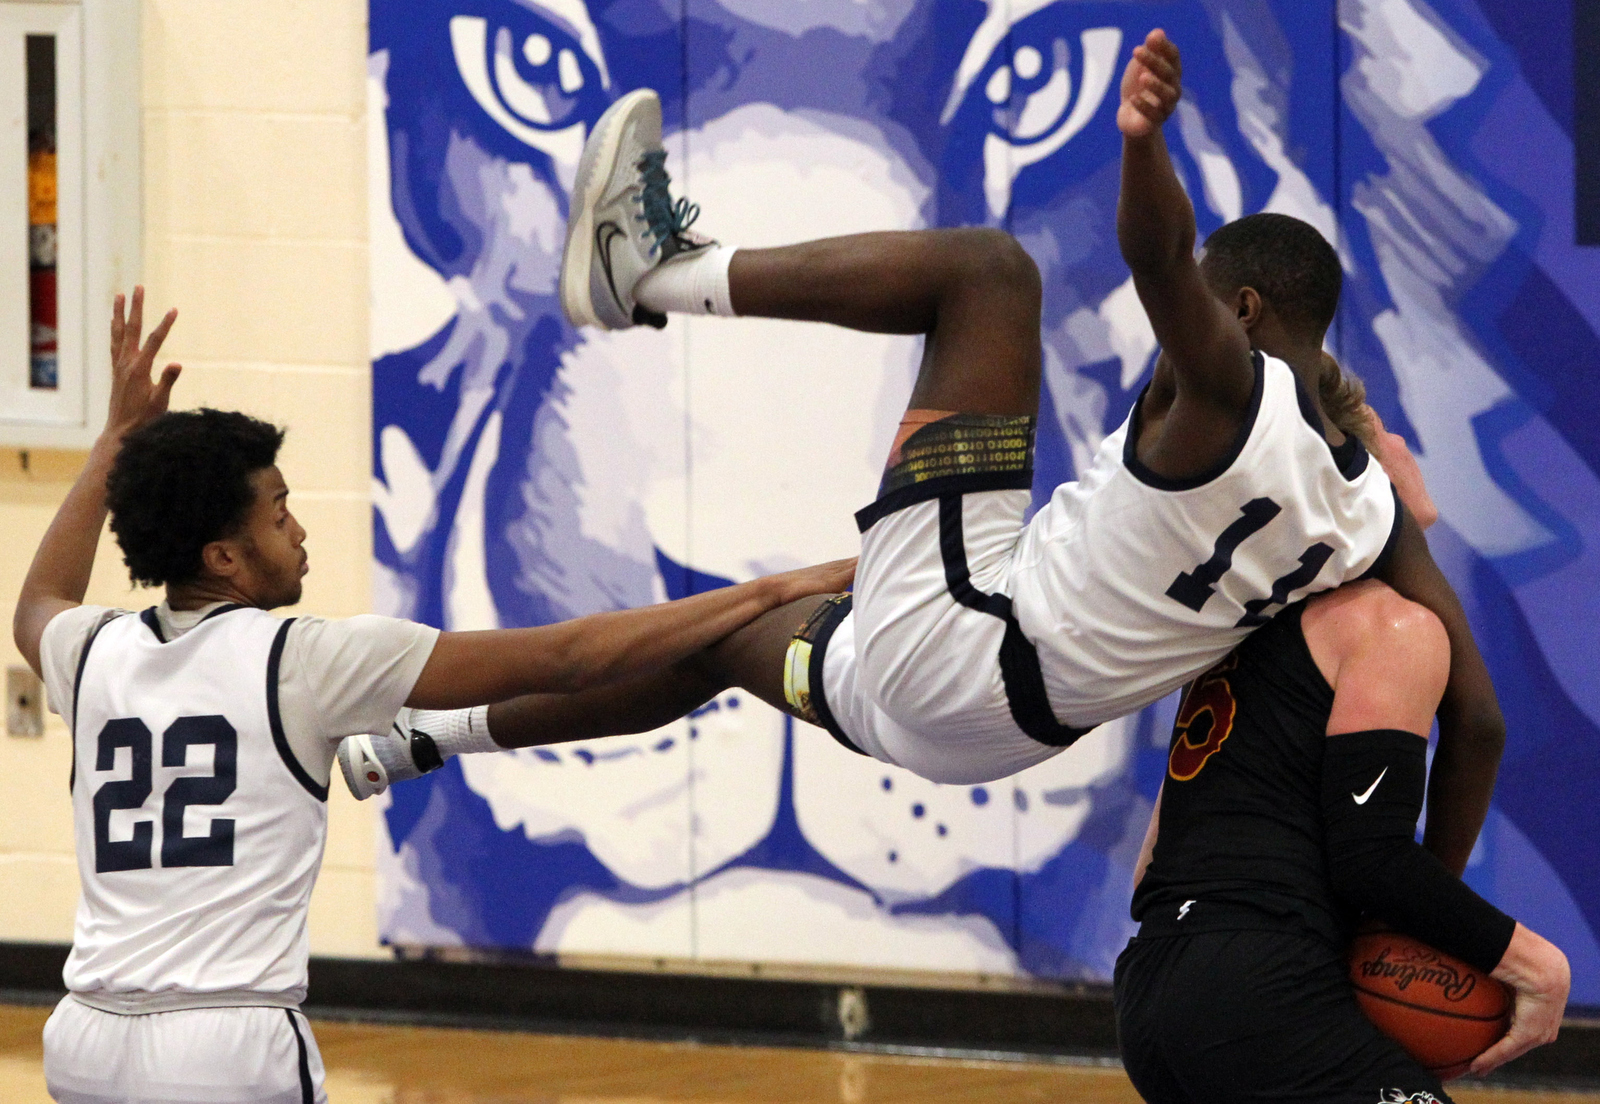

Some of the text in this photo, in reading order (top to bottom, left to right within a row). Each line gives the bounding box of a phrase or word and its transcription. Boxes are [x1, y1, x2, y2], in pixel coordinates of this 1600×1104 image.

[1165, 496, 1335, 628] 11
[1169, 650, 1238, 782] 5
[93, 714, 238, 874] 22
[1359, 946, 1477, 1003] Rawlings
